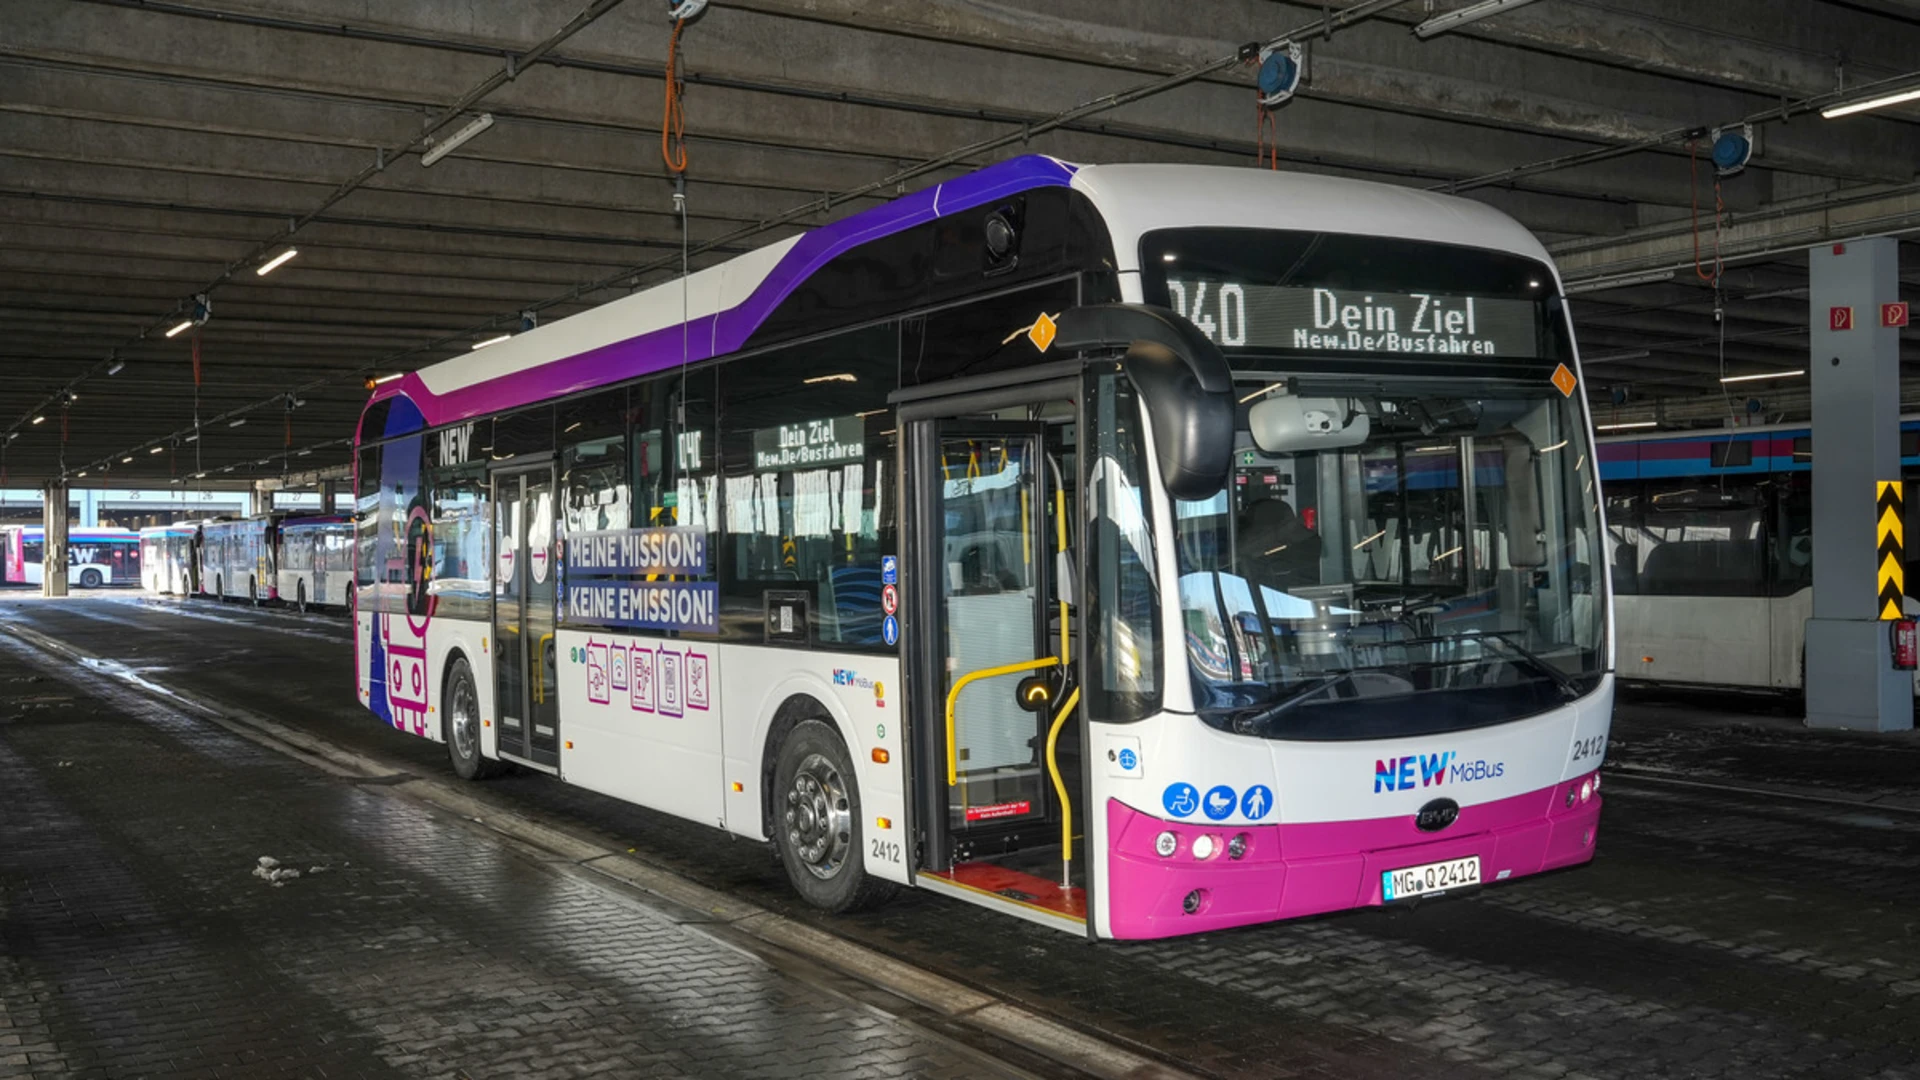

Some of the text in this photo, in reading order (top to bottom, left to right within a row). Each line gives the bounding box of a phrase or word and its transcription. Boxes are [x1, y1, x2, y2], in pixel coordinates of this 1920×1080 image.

[1313, 288, 1475, 335] Dein Ziel
[1294, 328, 1495, 355] New.De/Busfahren
[780, 418, 835, 447] Dein Ziel
[570, 532, 702, 568] MEINE MISSION:
[570, 586, 714, 626] KEINE EMISSION!
[1573, 735, 1604, 761] 2412
[1450, 760, 1504, 784] MöBus
[871, 838, 900, 864] 2412
[1393, 860, 1477, 895] MG Q 2412
